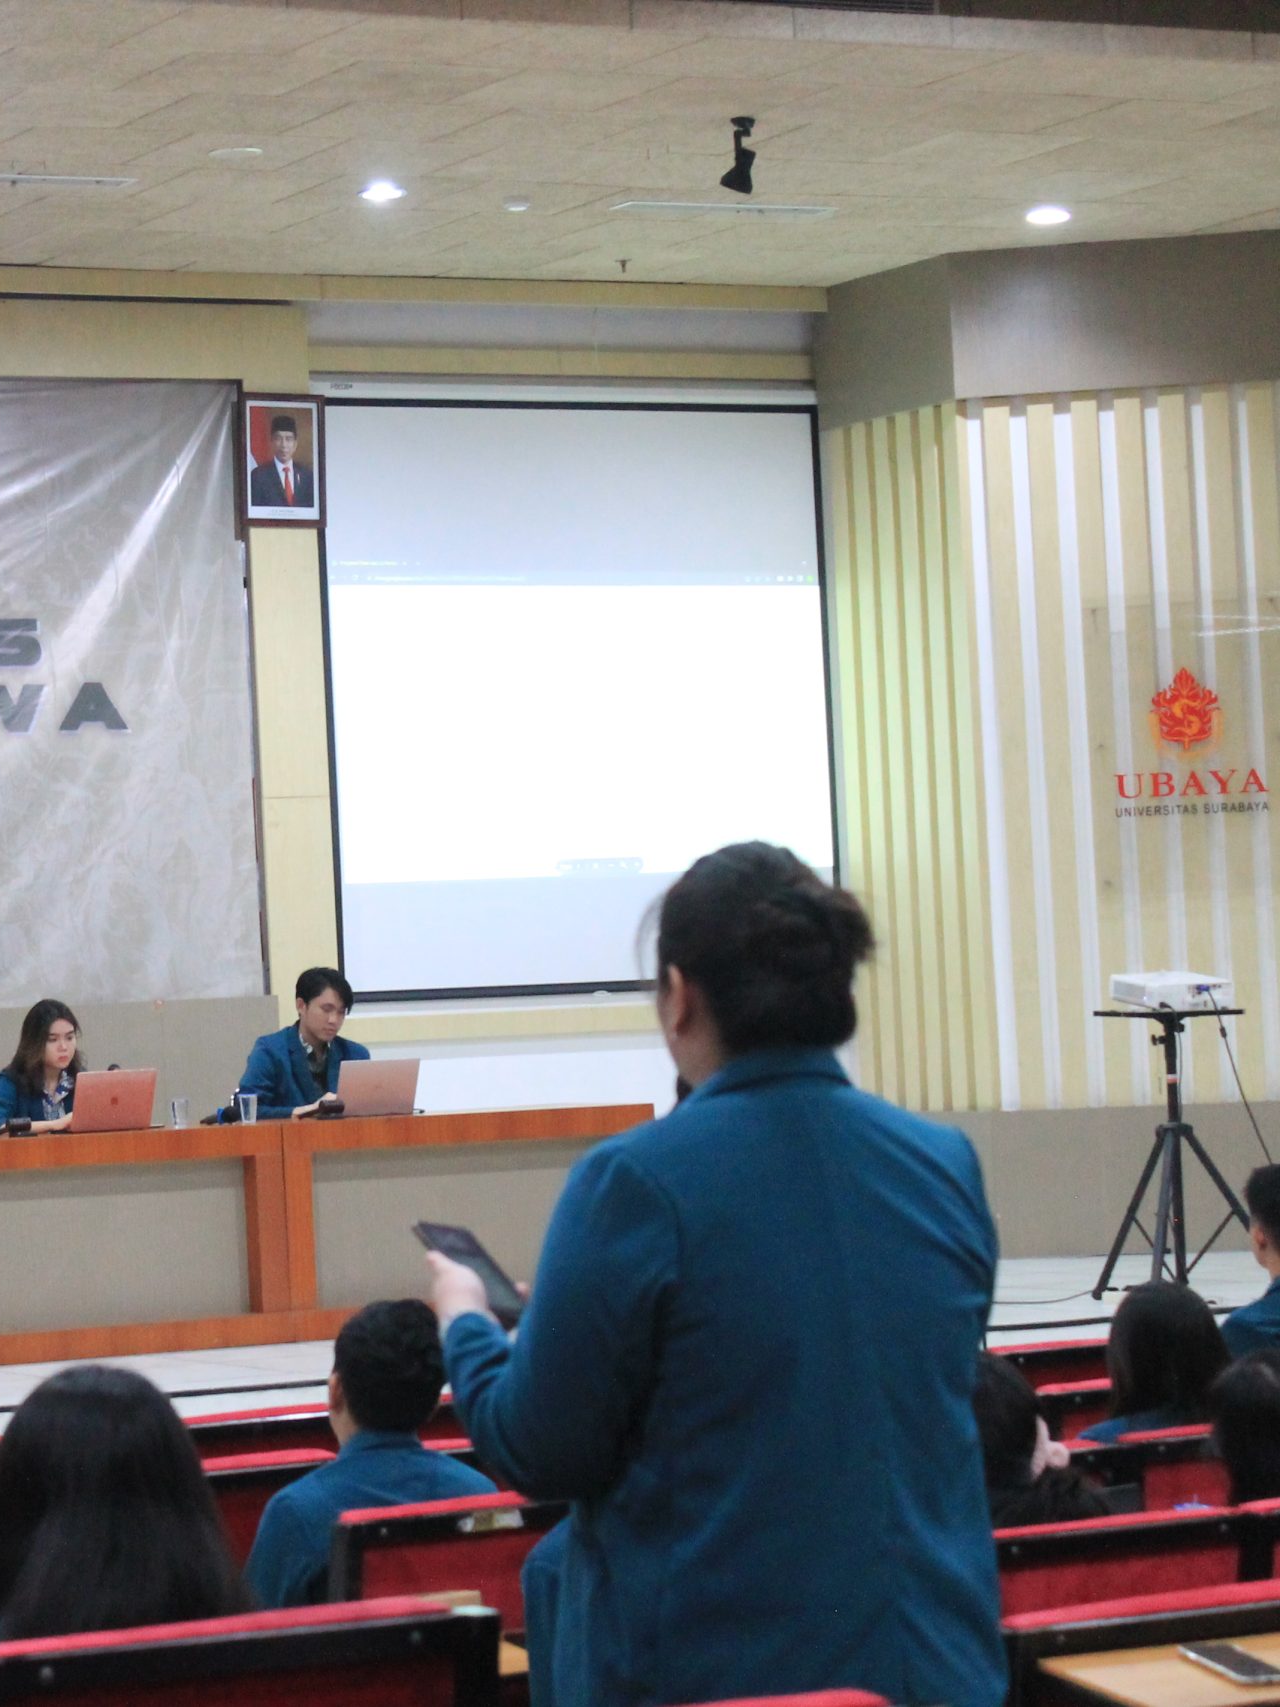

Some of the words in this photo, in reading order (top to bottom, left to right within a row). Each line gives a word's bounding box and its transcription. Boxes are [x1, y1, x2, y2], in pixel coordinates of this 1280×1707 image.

[1114, 767, 1269, 800] UBAYA
[1115, 804, 1199, 818] UNIVERSITAS
[1204, 801, 1270, 815] SURABAYA
